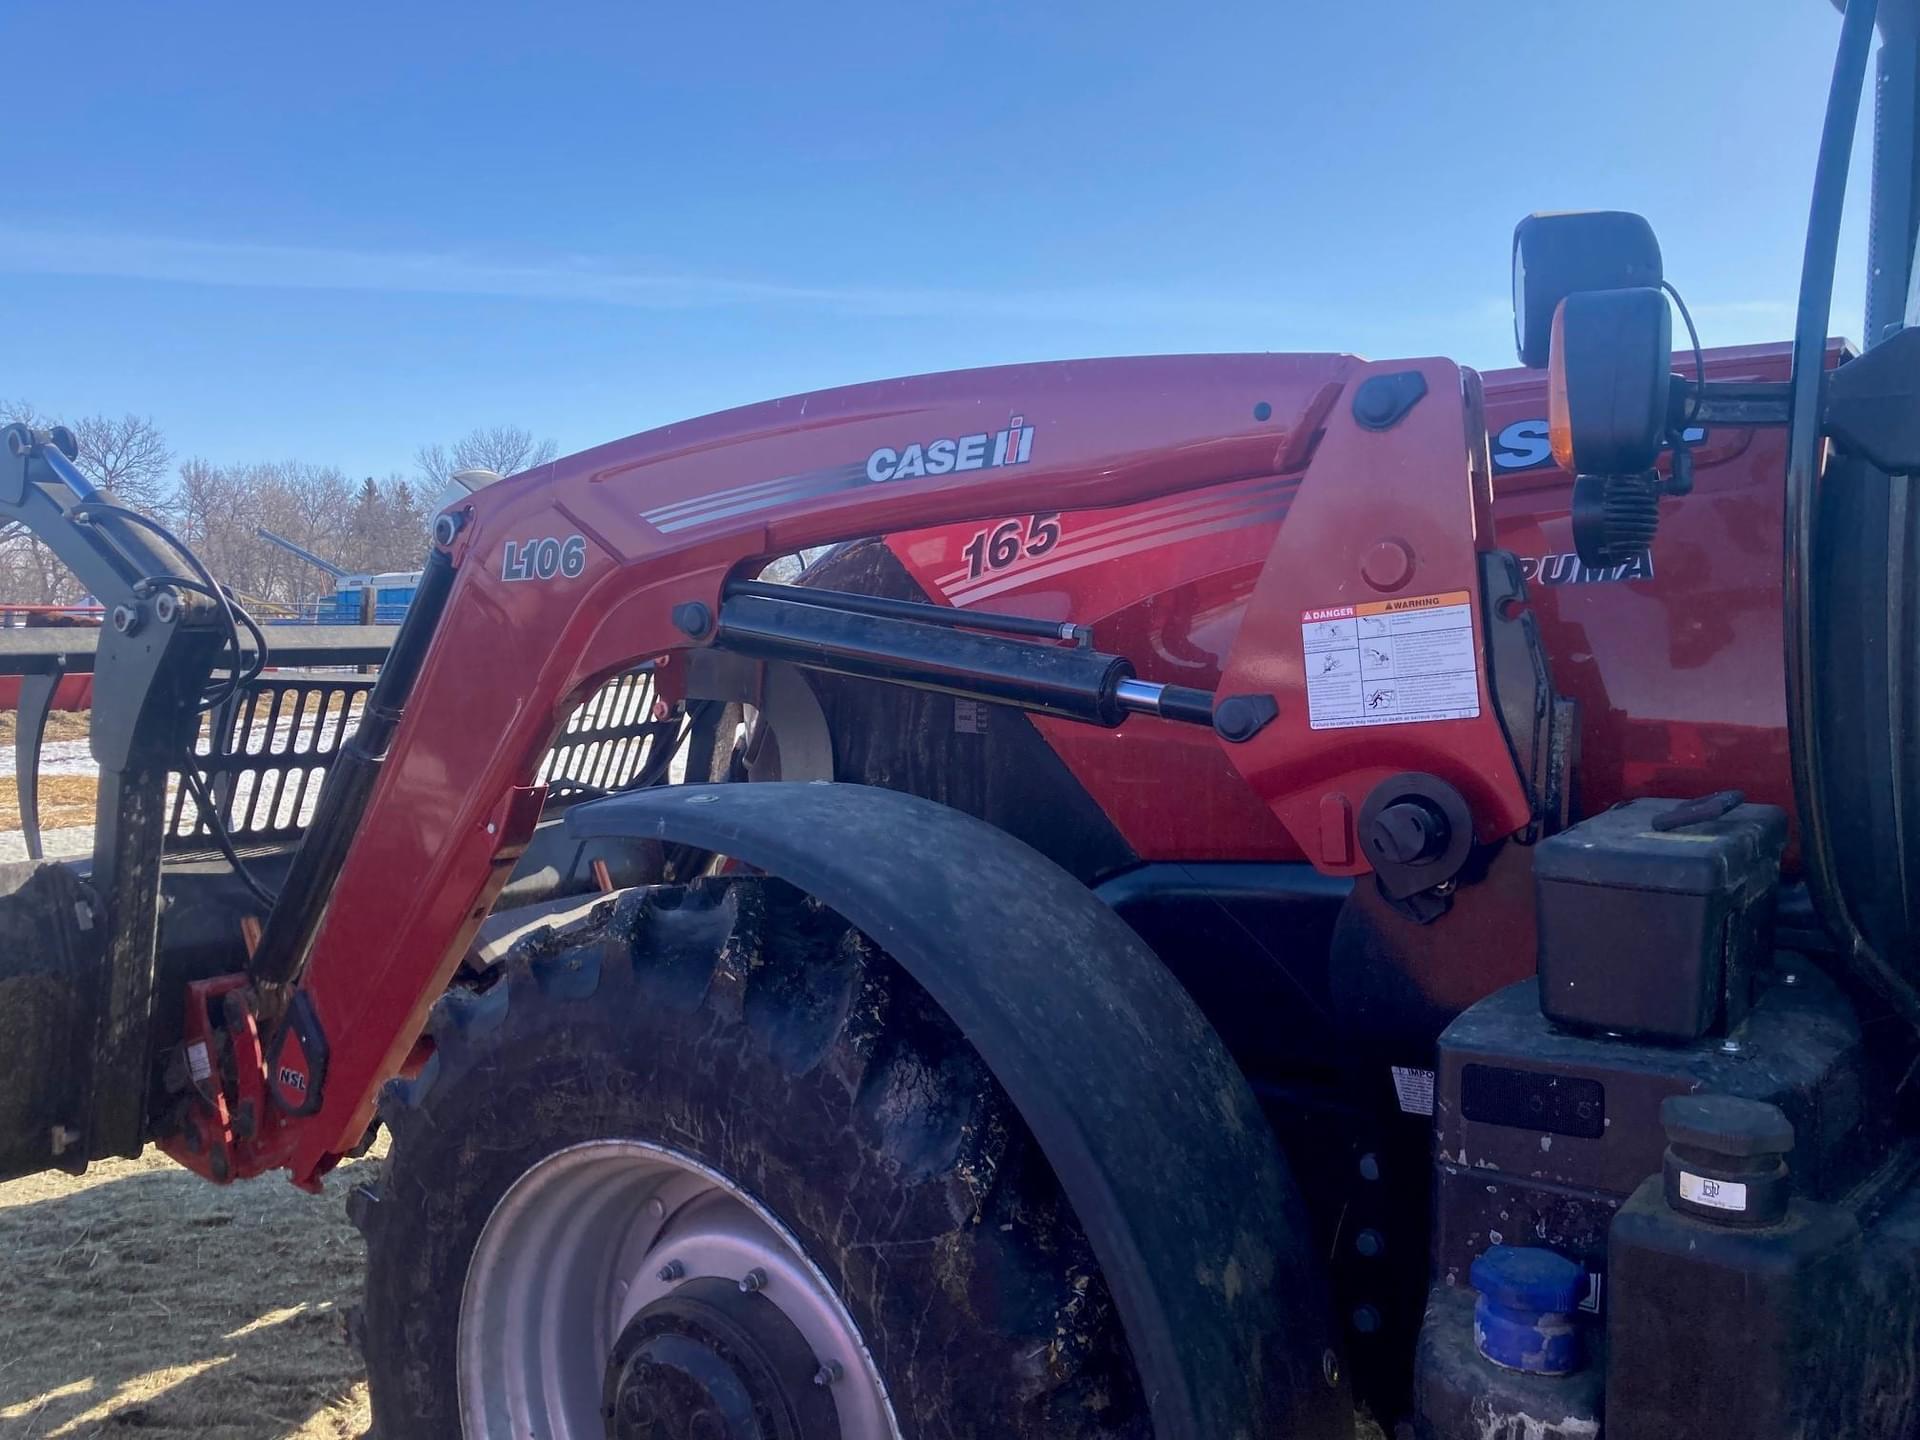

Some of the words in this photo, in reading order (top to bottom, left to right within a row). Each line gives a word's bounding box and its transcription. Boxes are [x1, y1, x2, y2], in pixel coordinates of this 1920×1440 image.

[866, 435, 990, 482] CASE
[502, 534, 586, 582] L106
[961, 513, 1062, 582] 165
[1312, 607, 1354, 620] DANGER
[1394, 597, 1440, 609] WARNING
